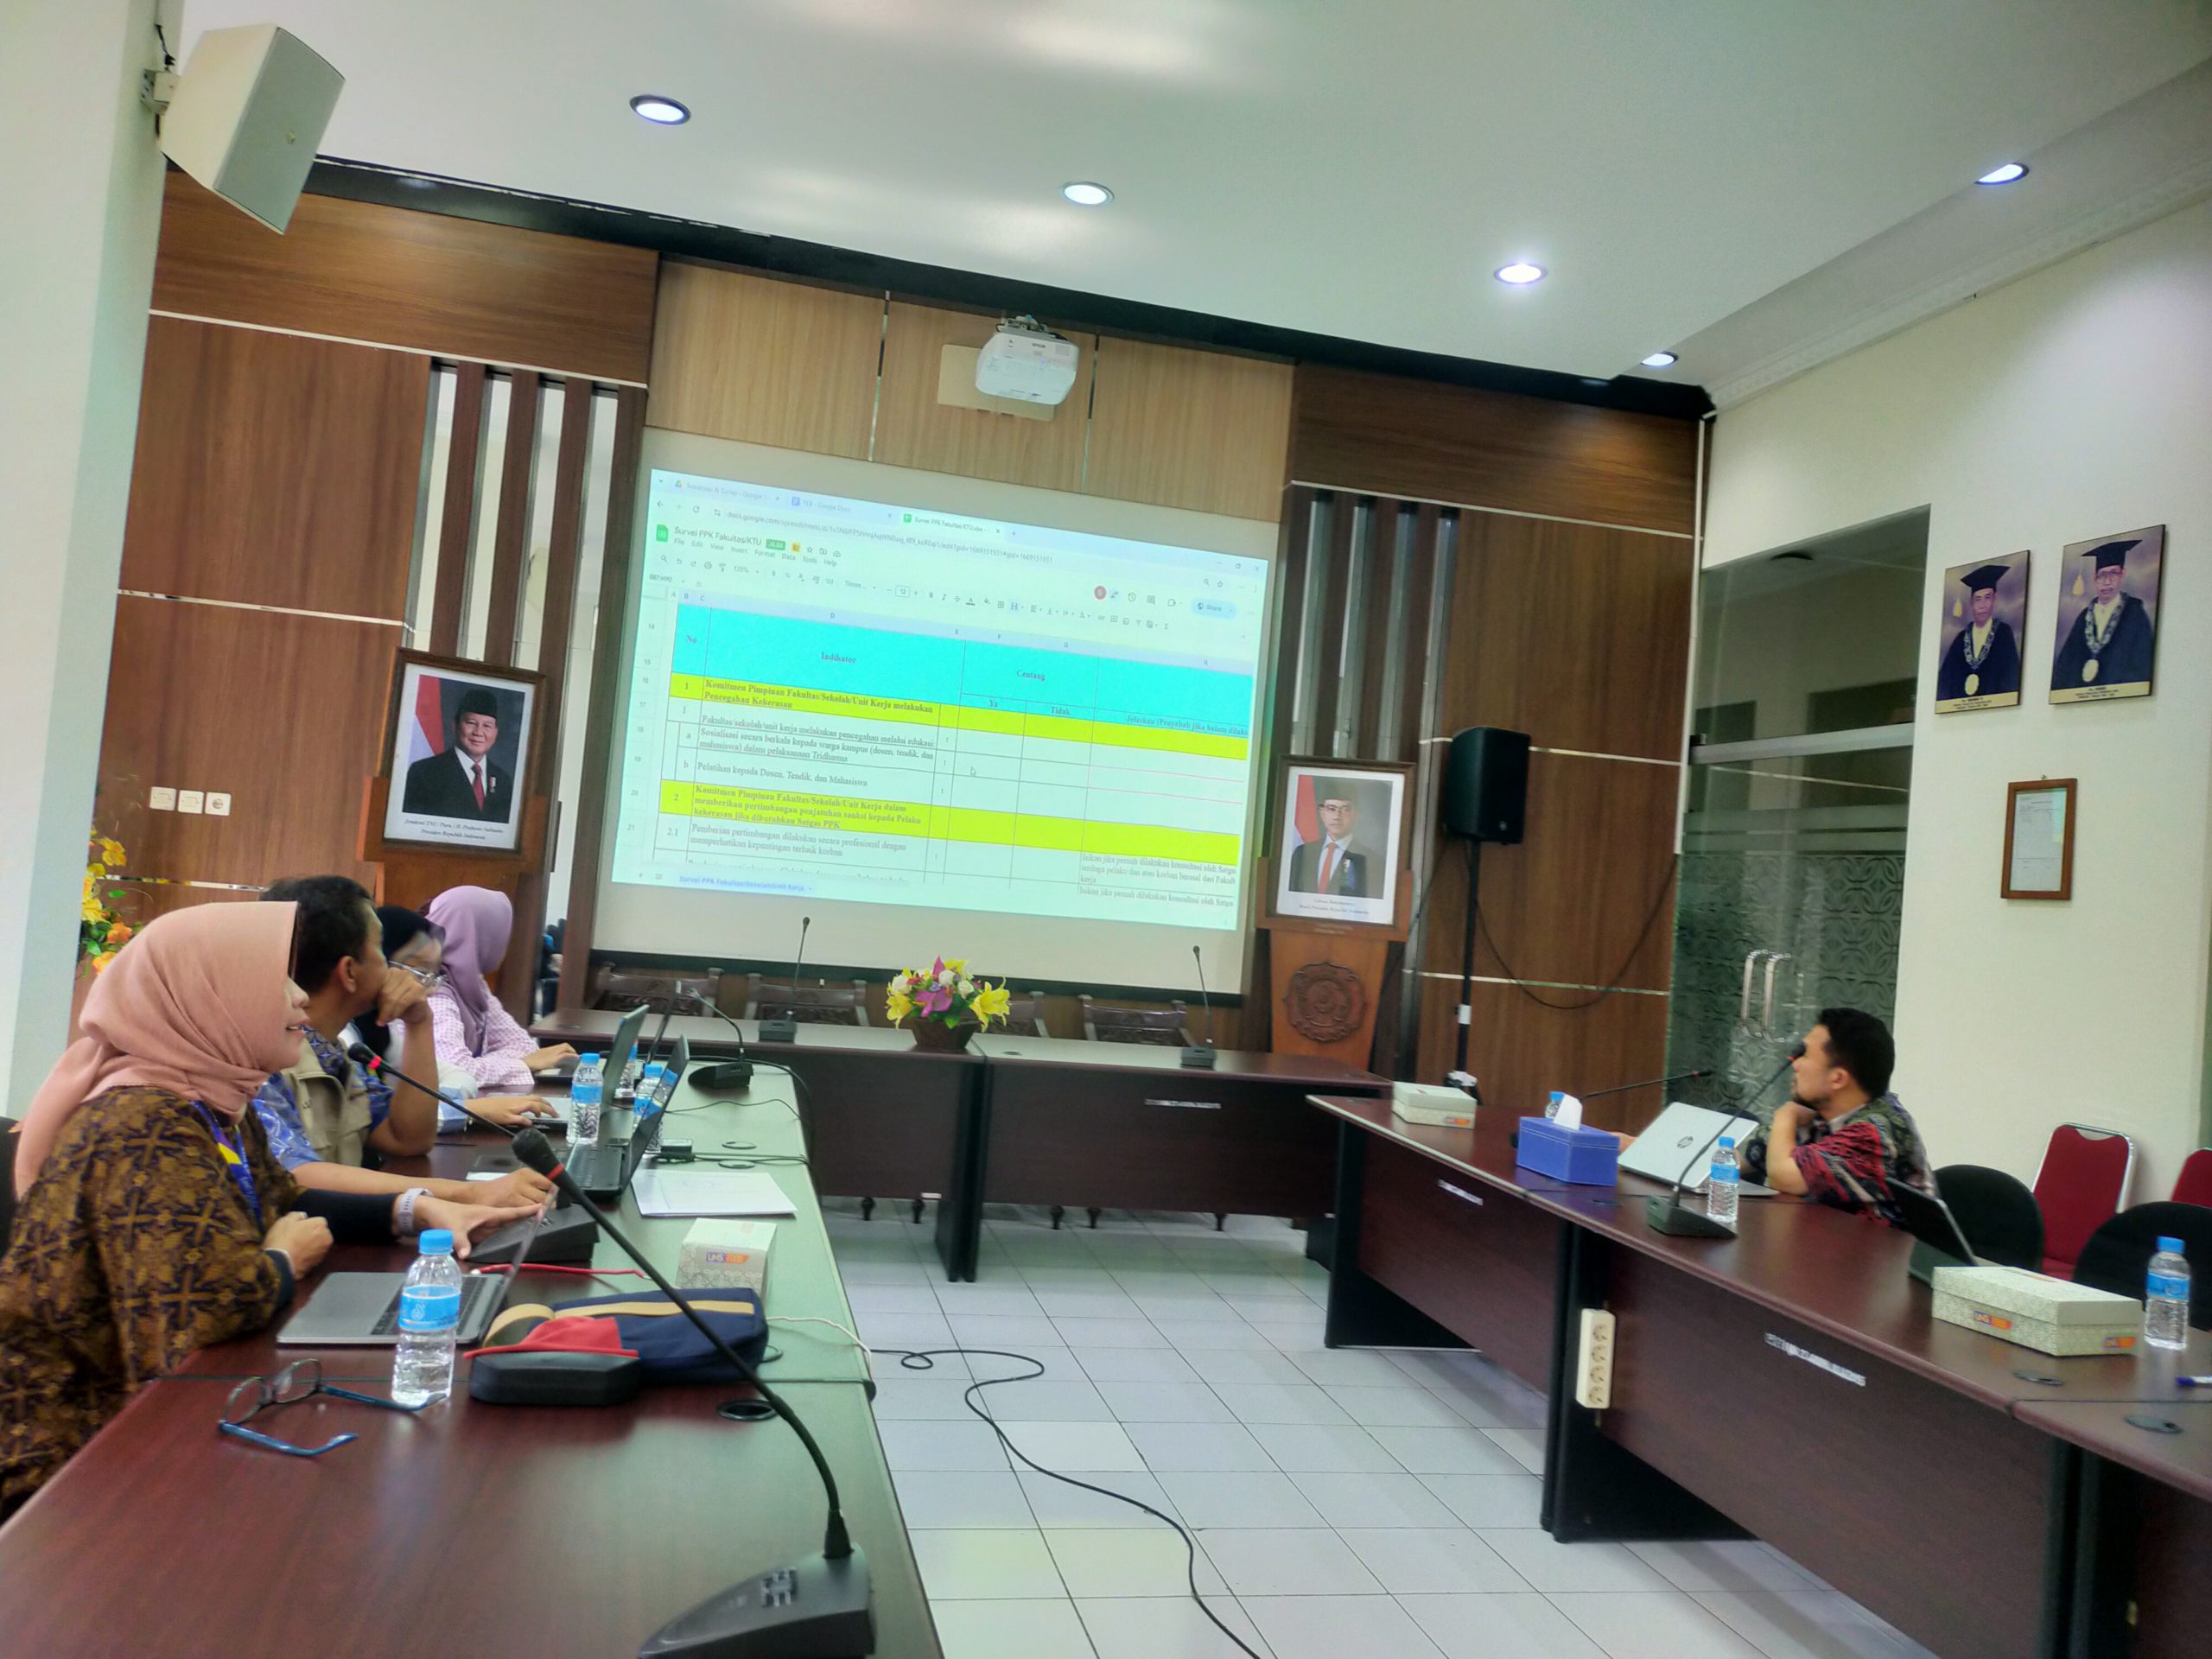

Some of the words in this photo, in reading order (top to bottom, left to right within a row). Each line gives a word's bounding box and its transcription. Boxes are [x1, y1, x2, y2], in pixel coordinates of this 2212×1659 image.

[674, 526, 697, 537] Survei
[698, 530, 714, 540] PPK
[715, 532, 761, 546] Fakultas/KTU
[674, 537, 684, 546] File
[691, 540, 702, 549] Edit
[710, 543, 723, 551] View
[731, 545, 747, 555] Insert
[754, 549, 775, 558] Format
[782, 552, 795, 561] Data
[802, 556, 817, 564] Tools
[823, 558, 836, 567] Help
[686, 634, 697, 644] No
[820, 652, 856, 664] Indikator
[1015, 669, 1046, 682] Centang
[704, 692, 750, 704] Pencegahan
[751, 697, 792, 708] Kekerasan
[705, 680, 746, 692] Komitmen
[748, 685, 785, 697] Pimpinan
[786, 690, 868, 706] Fakultas/Sekolah/Unit
[869, 699, 891, 709] Kerja
[893, 702, 933, 713] melakukan
[988, 699, 998, 708] Ya
[1050, 705, 1071, 715] Tidak
[702, 715, 778, 730] Fakultas/sekolah/unit
[779, 723, 798, 734] kerja
[798, 725, 836, 736] melakukan
[838, 730, 879, 742] pencegahan
[880, 734, 906, 744] melalui
[699, 740, 741, 752] mahasiswa)
[744, 744, 766, 753] dalam
[767, 747, 810, 759] pelaksanaan
[812, 751, 848, 762] Tridharma
[700, 728, 738, 739] Sosialisasi
[740, 732, 763, 741] secara
[764, 734, 791, 745] berkala
[792, 738, 817, 748] kepada
[818, 742, 840, 752] warga
[841, 743, 868, 754] kampus
[920, 751, 933, 760] dan
[696, 762, 731, 772] Pelatihan
[732, 766, 758, 777] kepada
[814, 773, 827, 782] dan
[829, 775, 868, 786] Mahasiswa
[696, 785, 736, 797] Komitmen
[738, 790, 774, 801] Pimpinan
[777, 793, 859, 808] Fakultas/Sekolah/Unit
[860, 801, 881, 811] Kerja
[884, 803, 906, 812] dalam
[693, 808, 733, 818] kekerasan
[734, 811, 749, 821] jika
[751, 813, 795, 823] dibutuhkan
[797, 817, 821, 828] Satgas
[823, 819, 840, 828] PPK
[694, 797, 743, 808] memberikan
[744, 801, 798, 815] pertimbangan
[799, 806, 842, 818] penjatuhan
[843, 810, 867, 819] sanksi
[868, 812, 894, 823] kepada
[896, 815, 920, 824] Pelaku
[666, 828, 678, 836] 2.1
[691, 823, 730, 835] Pemberian
[732, 827, 780, 841] pertimbangan
[782, 831, 817, 842] dilakukan
[818, 836, 839, 844] secara
[841, 836, 881, 849] profesional
[883, 841, 906, 852] dengan
[690, 836, 746, 849] memperhatikan
[747, 840, 791, 853] kepentingan
[792, 844, 817, 854] terbaik
[817, 846, 843, 855] korban
[1102, 855, 1115, 864] jika
[1116, 856, 1137, 866] pernah
[1139, 858, 1169, 868] dilakukan
[1204, 863, 1217, 872] oleh
[1106, 866, 1127, 876] pelaku
[1128, 868, 1140, 876] dan
[1156, 870, 1178, 879] korban
[1179, 873, 1201, 881] berasal
[1099, 888, 1112, 897] jika
[1114, 889, 1135, 899] pernah
[1136, 891, 1166, 900] dilakukan
[1201, 896, 1214, 905] oleh
